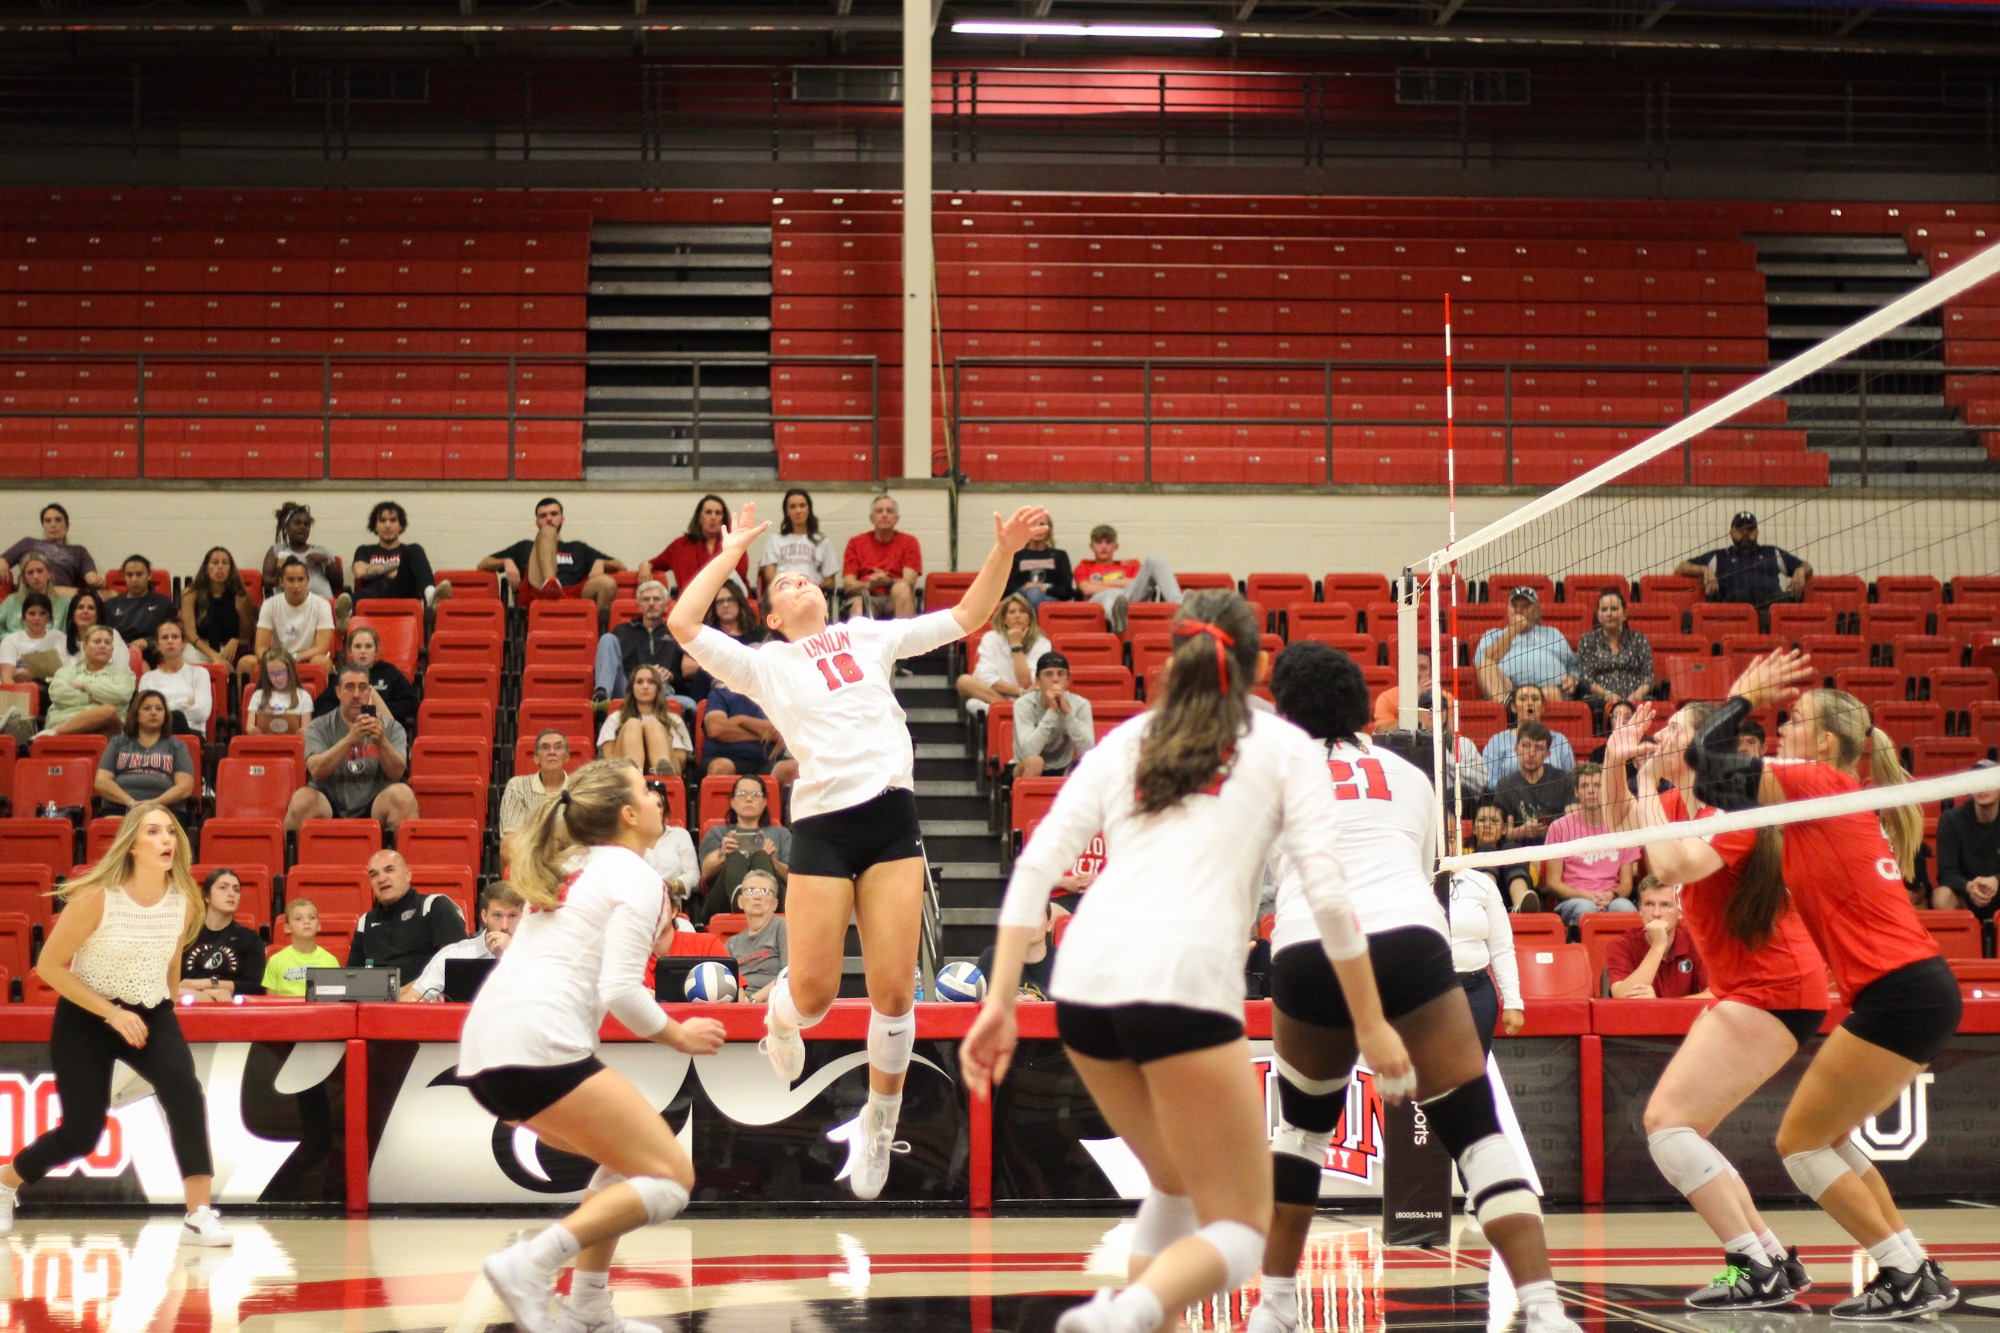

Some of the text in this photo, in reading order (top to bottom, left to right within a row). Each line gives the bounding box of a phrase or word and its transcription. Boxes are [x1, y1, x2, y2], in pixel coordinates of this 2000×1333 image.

[803, 631, 852, 659] UNION
[817, 652, 864, 691] 18
[117, 752, 174, 773] UNION
[1327, 757, 1392, 801] 21
[1395, 1211, 1443, 1220] (800)556-3198
